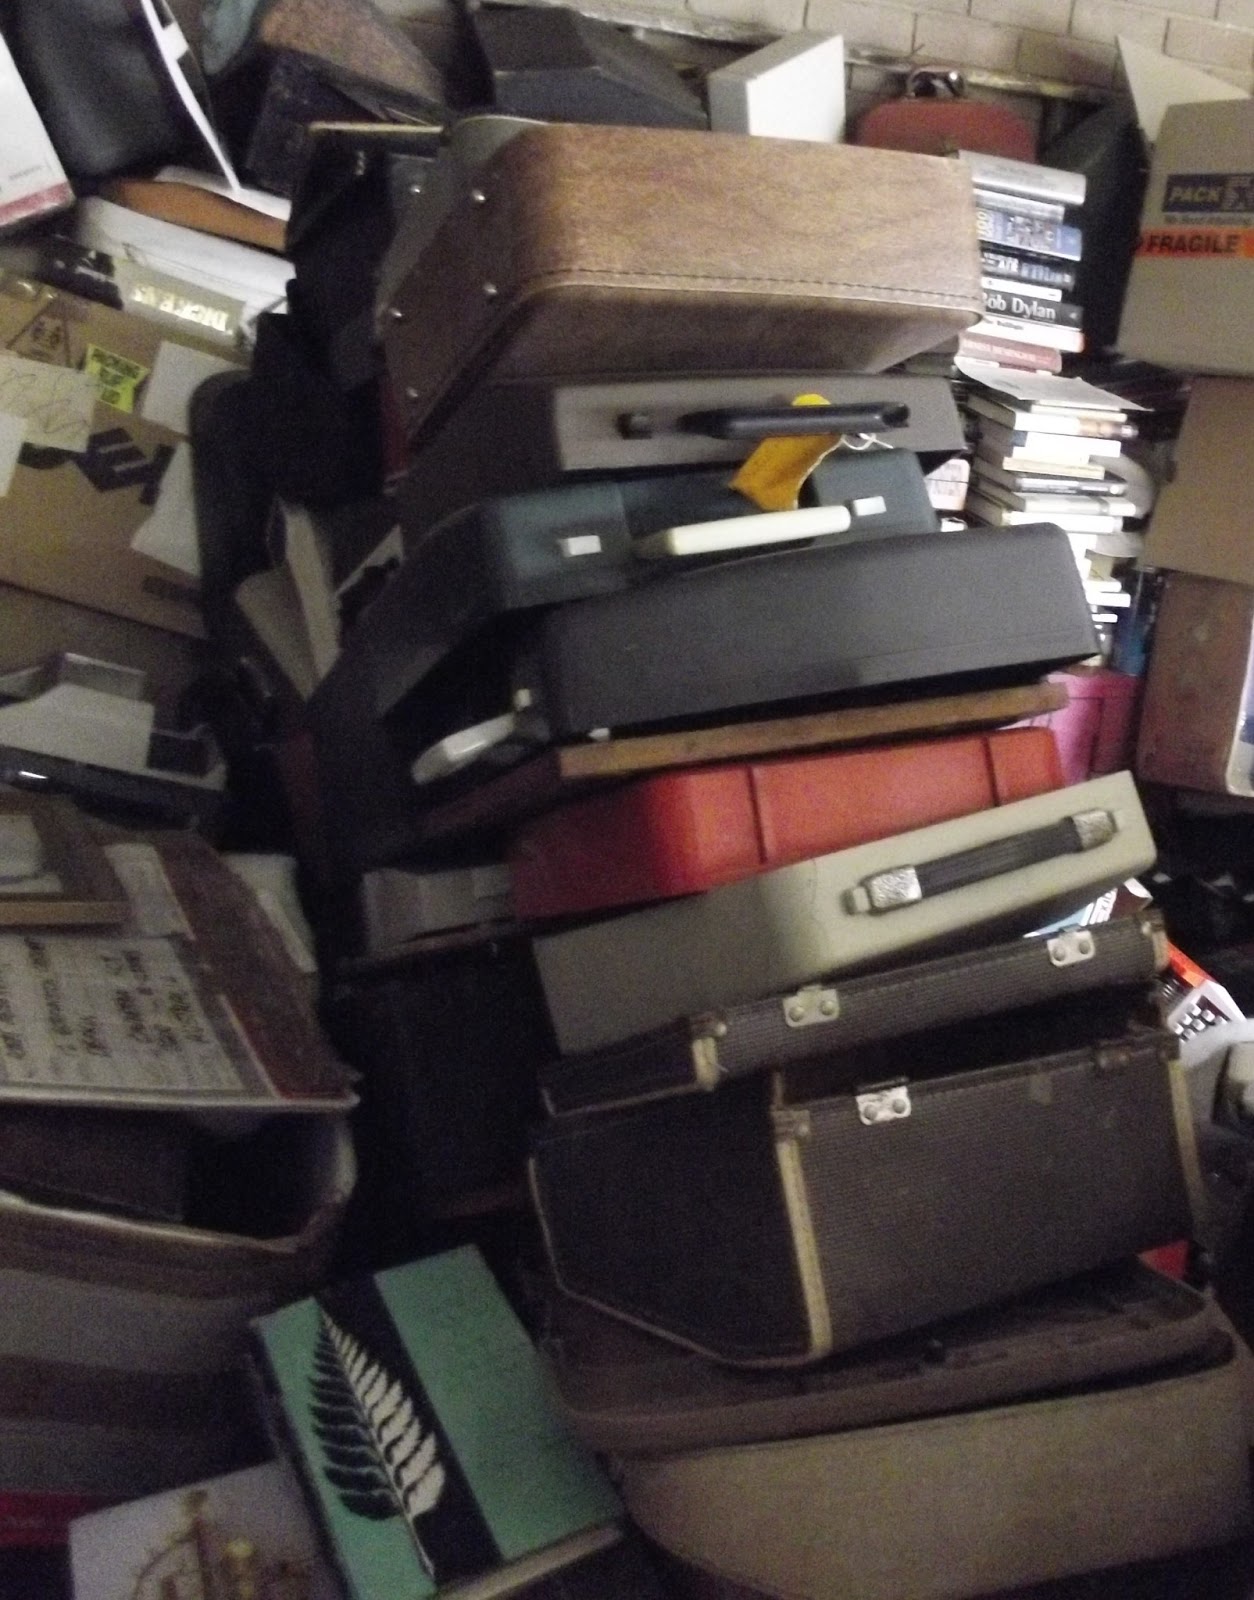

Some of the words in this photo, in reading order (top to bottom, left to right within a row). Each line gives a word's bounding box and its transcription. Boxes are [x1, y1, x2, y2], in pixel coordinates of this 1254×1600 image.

[1168, 186, 1223, 202] PACK
[1146, 234, 1241, 254] FRAGILE
[1011, 297, 1056, 319] Dylan
